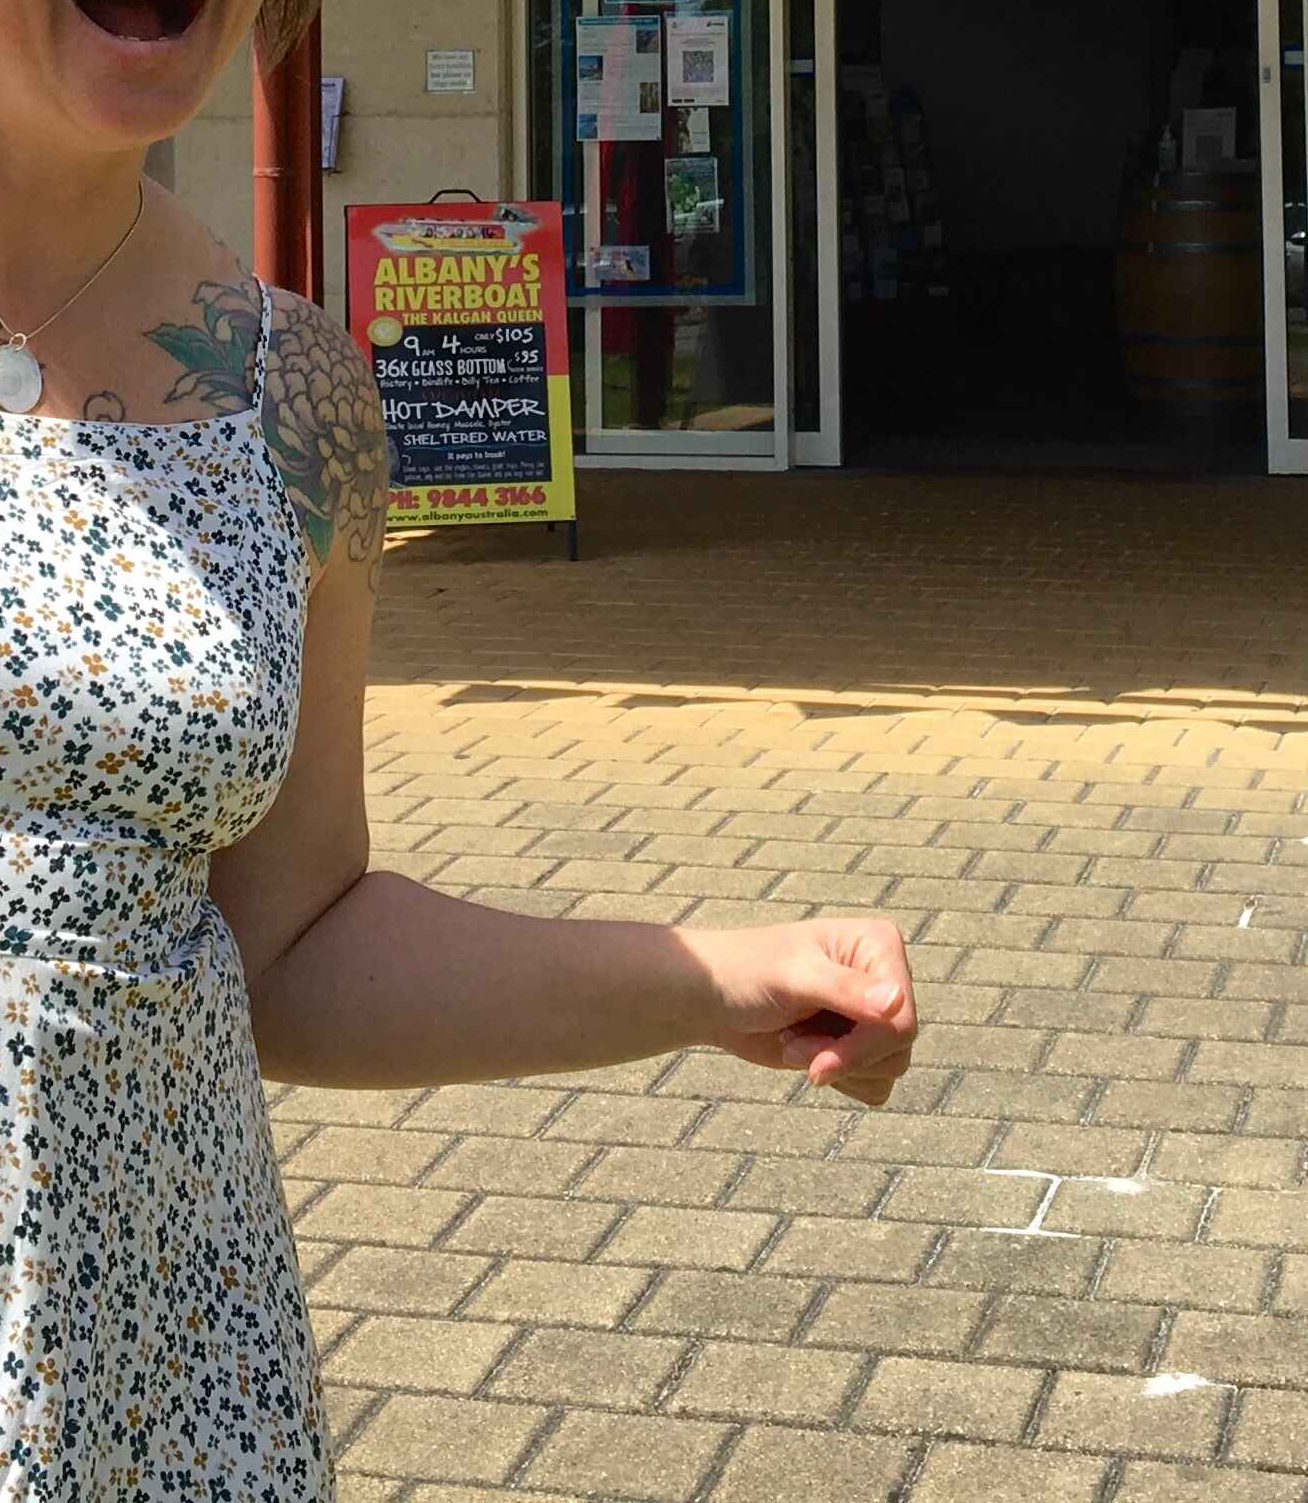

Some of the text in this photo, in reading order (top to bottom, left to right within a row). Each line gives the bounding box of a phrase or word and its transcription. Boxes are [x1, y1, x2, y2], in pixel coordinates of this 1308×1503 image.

[373, 253, 541, 286] ALBANY'S
[375, 283, 542, 312] RIVERBOAT
[402, 309, 543, 326] THE KALGAN QUEEN
[403, 335, 421, 357] 9
[422, 348, 436, 357] AM
[441, 334, 462, 355] 4
[459, 346, 488, 355] HOURS
[495, 327, 535, 344] $105
[411, 359, 454, 377] GLASS
[456, 357, 507, 376] BOTTOM
[382, 398, 546, 423] HOT DAMPER
[402, 429, 548, 446] SHELTERED WATER
[388, 484, 548, 510] PH: 9844 3166
[386, 508, 549, 523] www.albanyaustralia.com
